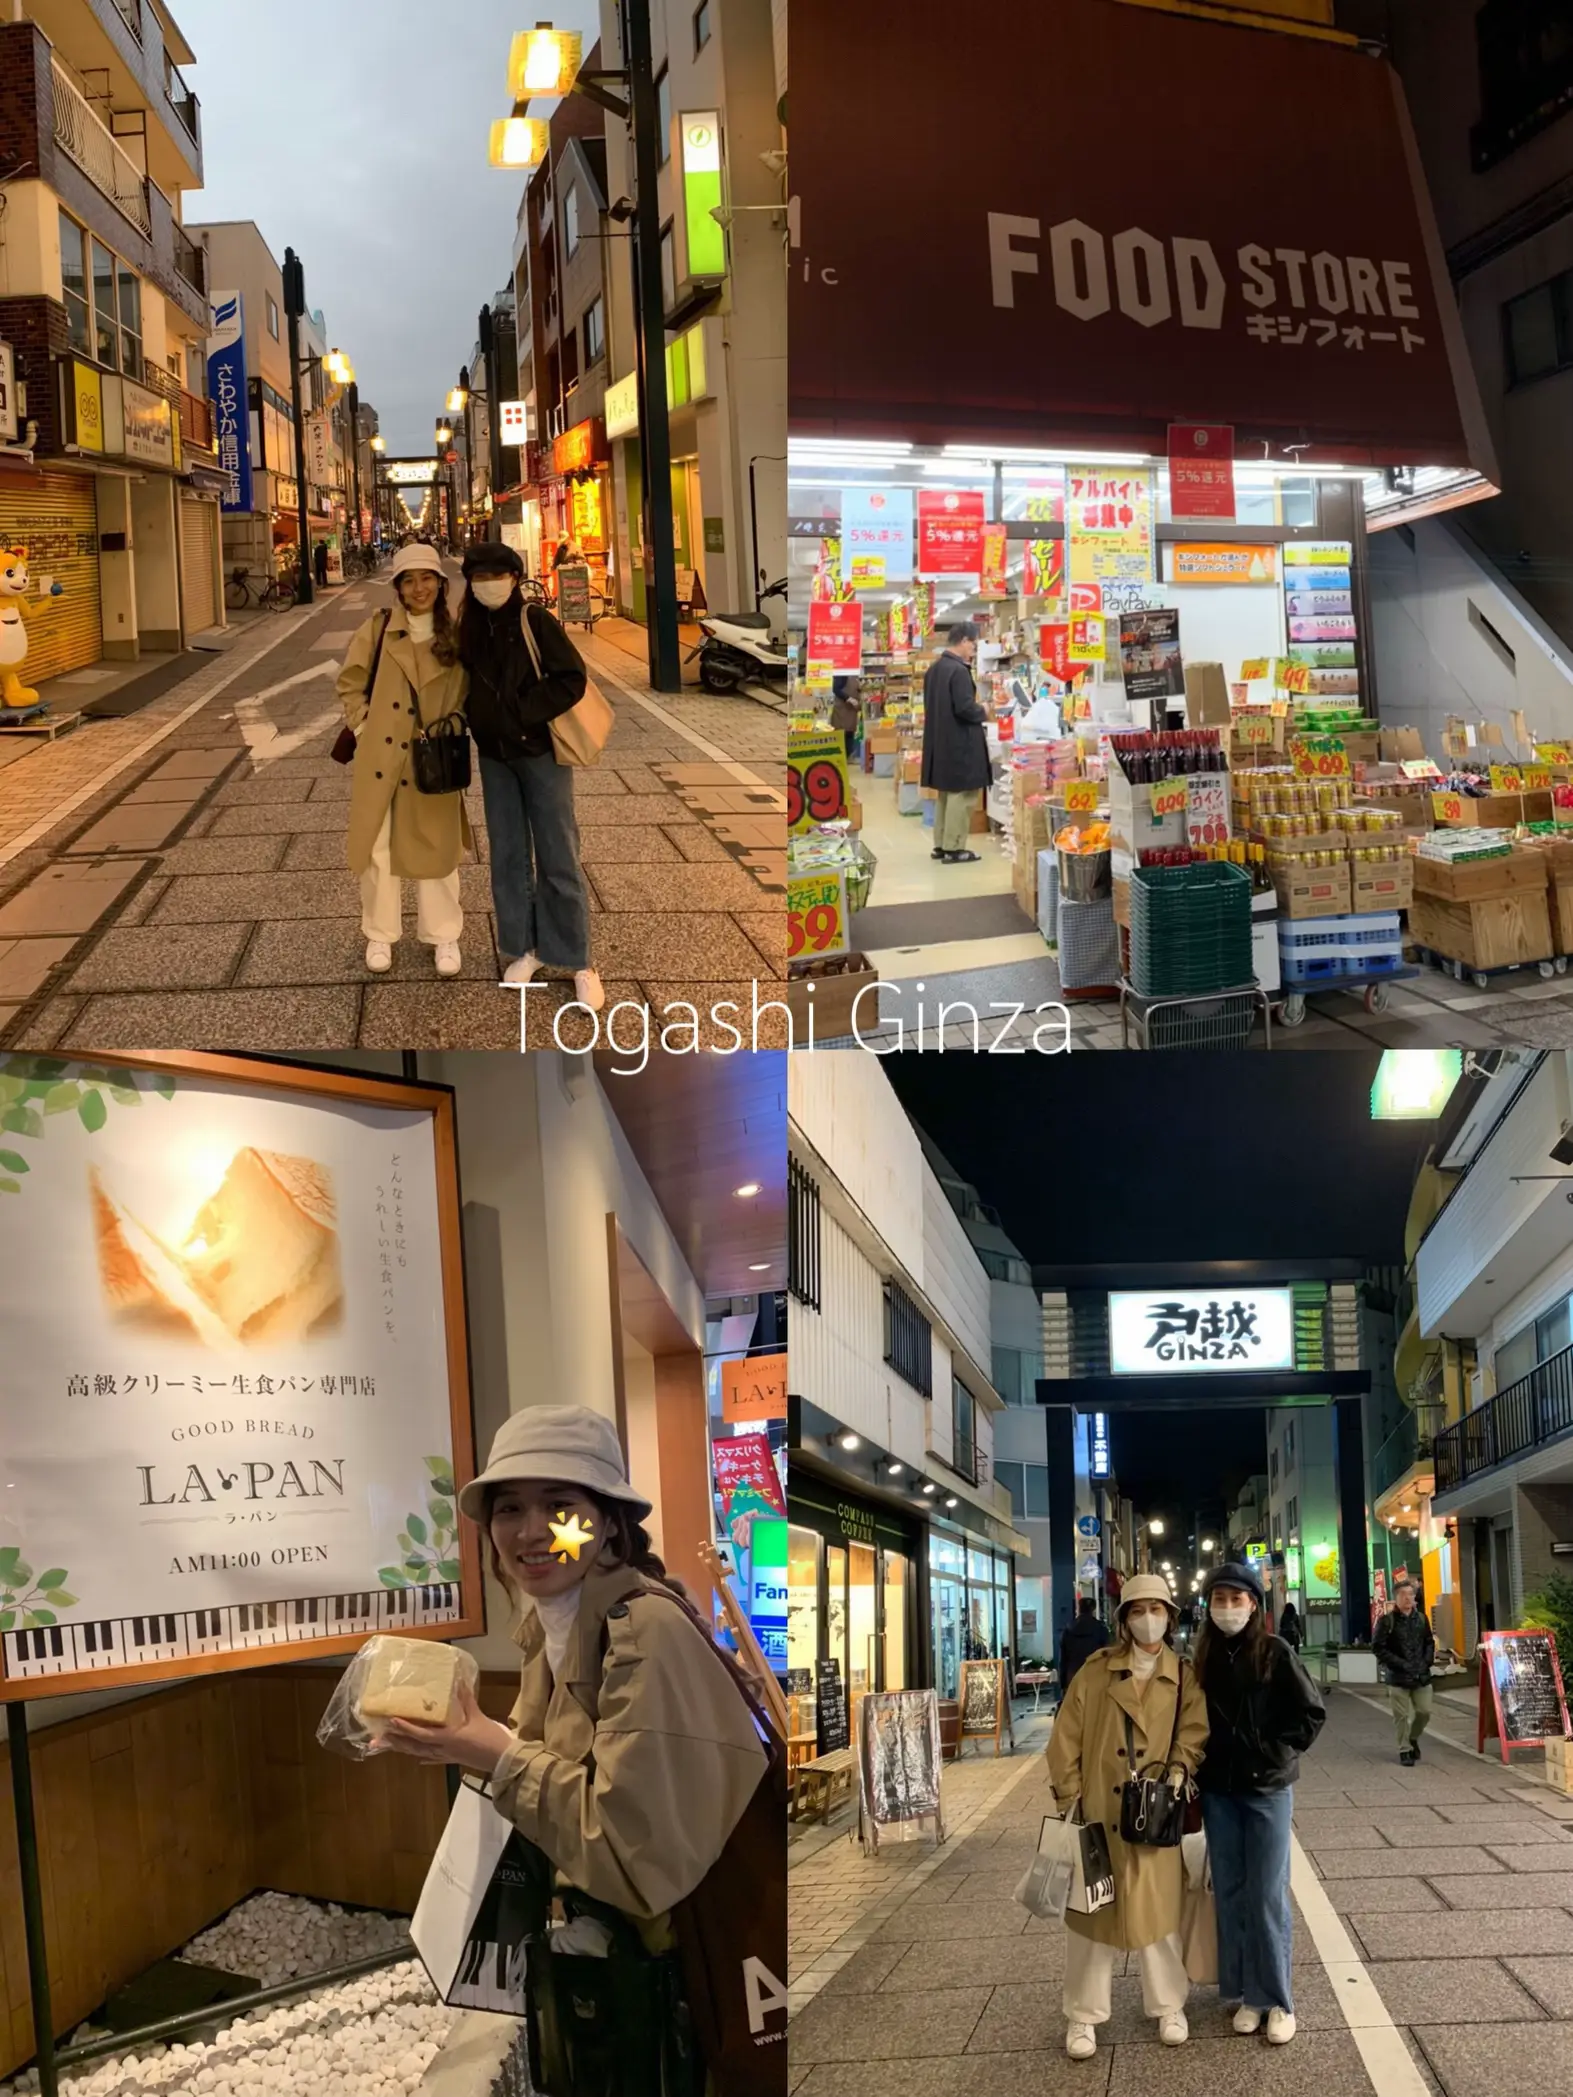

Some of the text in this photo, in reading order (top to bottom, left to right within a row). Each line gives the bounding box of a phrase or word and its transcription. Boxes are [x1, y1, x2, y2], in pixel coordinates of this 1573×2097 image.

[988, 212, 1419, 329] FOOD STORE
[1246, 314, 1425, 353] キシフォート
[1144, 1301, 1261, 1348] 戸越
[66, 1374, 376, 1397] 高級クリーミー生食パン専門店
[171, 1419, 315, 1442] GOOD BREAD
[838, 1503, 874, 1527] COMPASS
[841, 1520, 873, 1541] COFFEE
[168, 1545, 329, 1575] AM11:00 OPEN
